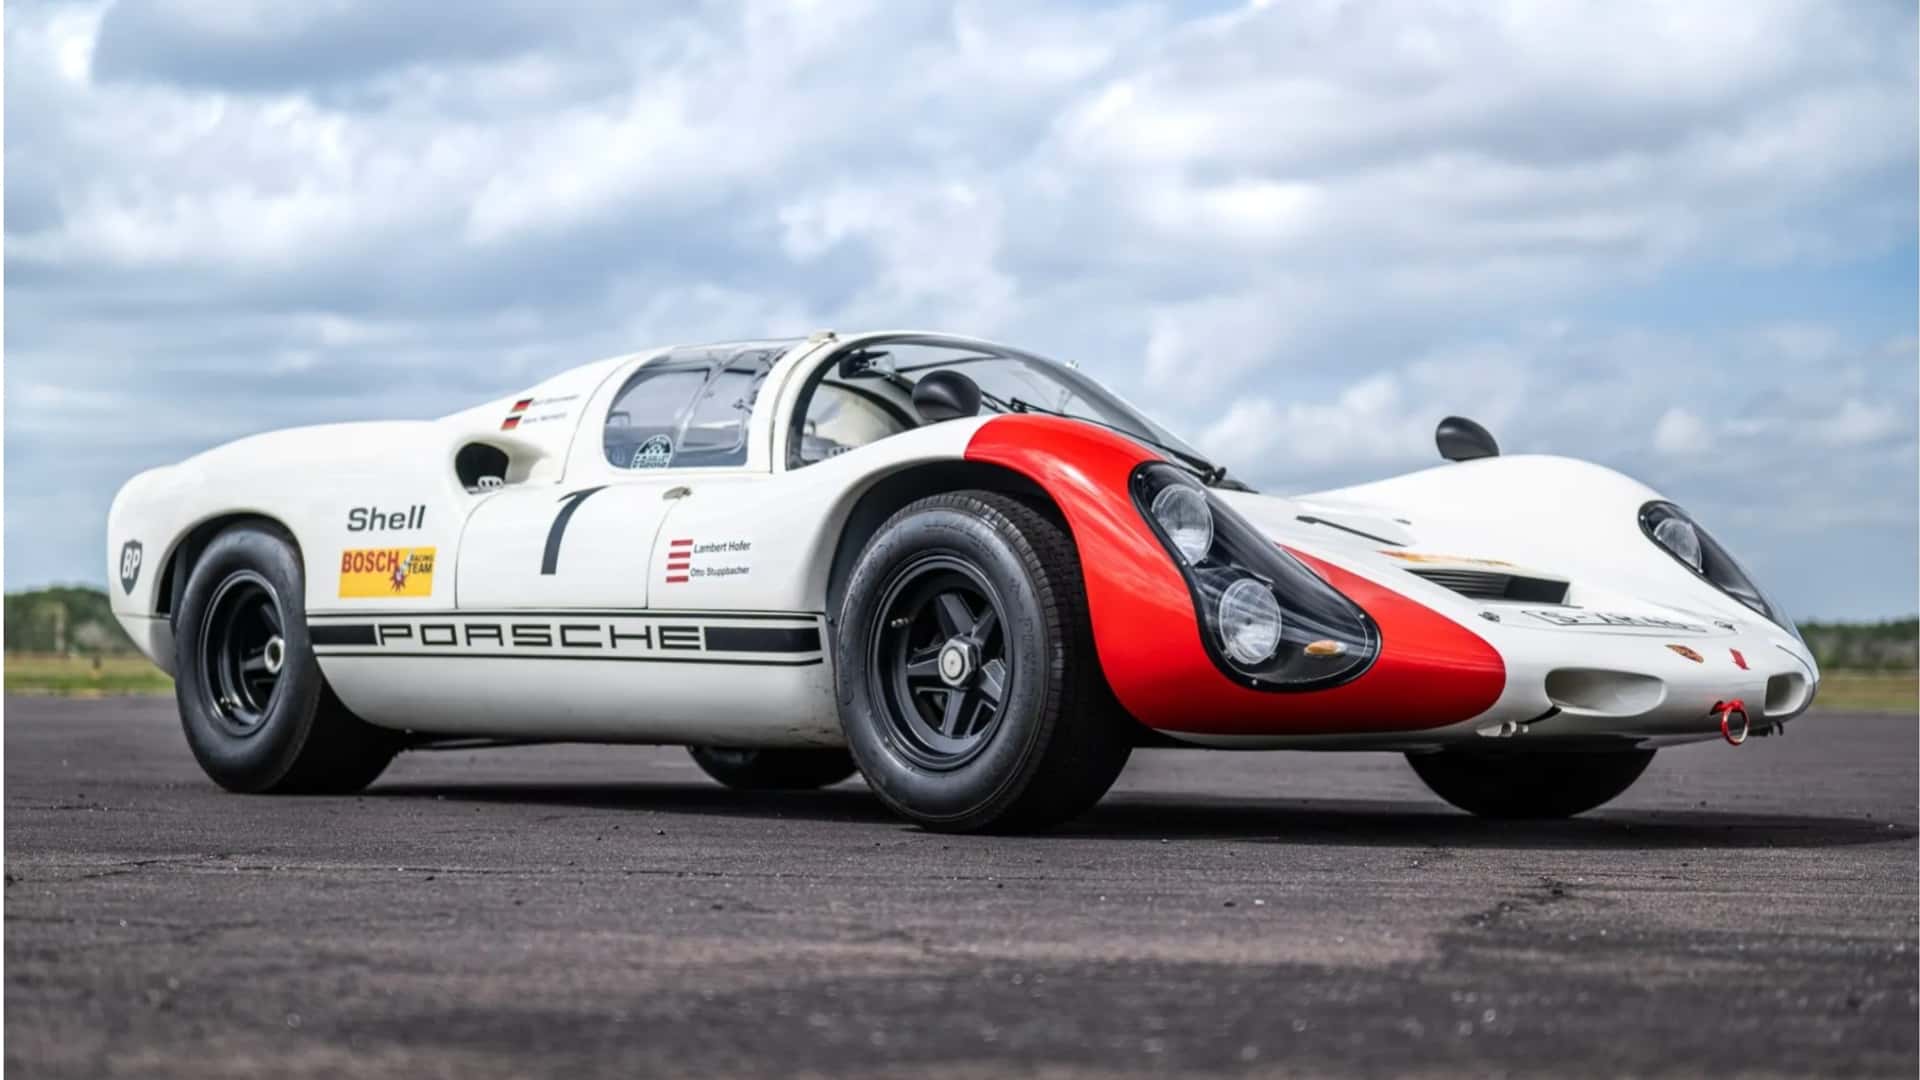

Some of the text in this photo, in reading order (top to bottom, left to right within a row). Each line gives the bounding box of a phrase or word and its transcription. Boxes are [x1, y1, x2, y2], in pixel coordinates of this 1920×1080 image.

[347, 505, 426, 531] Shell
[694, 541, 751, 554] Lambert Hofer
[122, 548, 140, 579] BP
[342, 550, 400, 573] BOSCH
[408, 562, 433, 574] TEAM
[378, 624, 702, 650] PORSCHE
